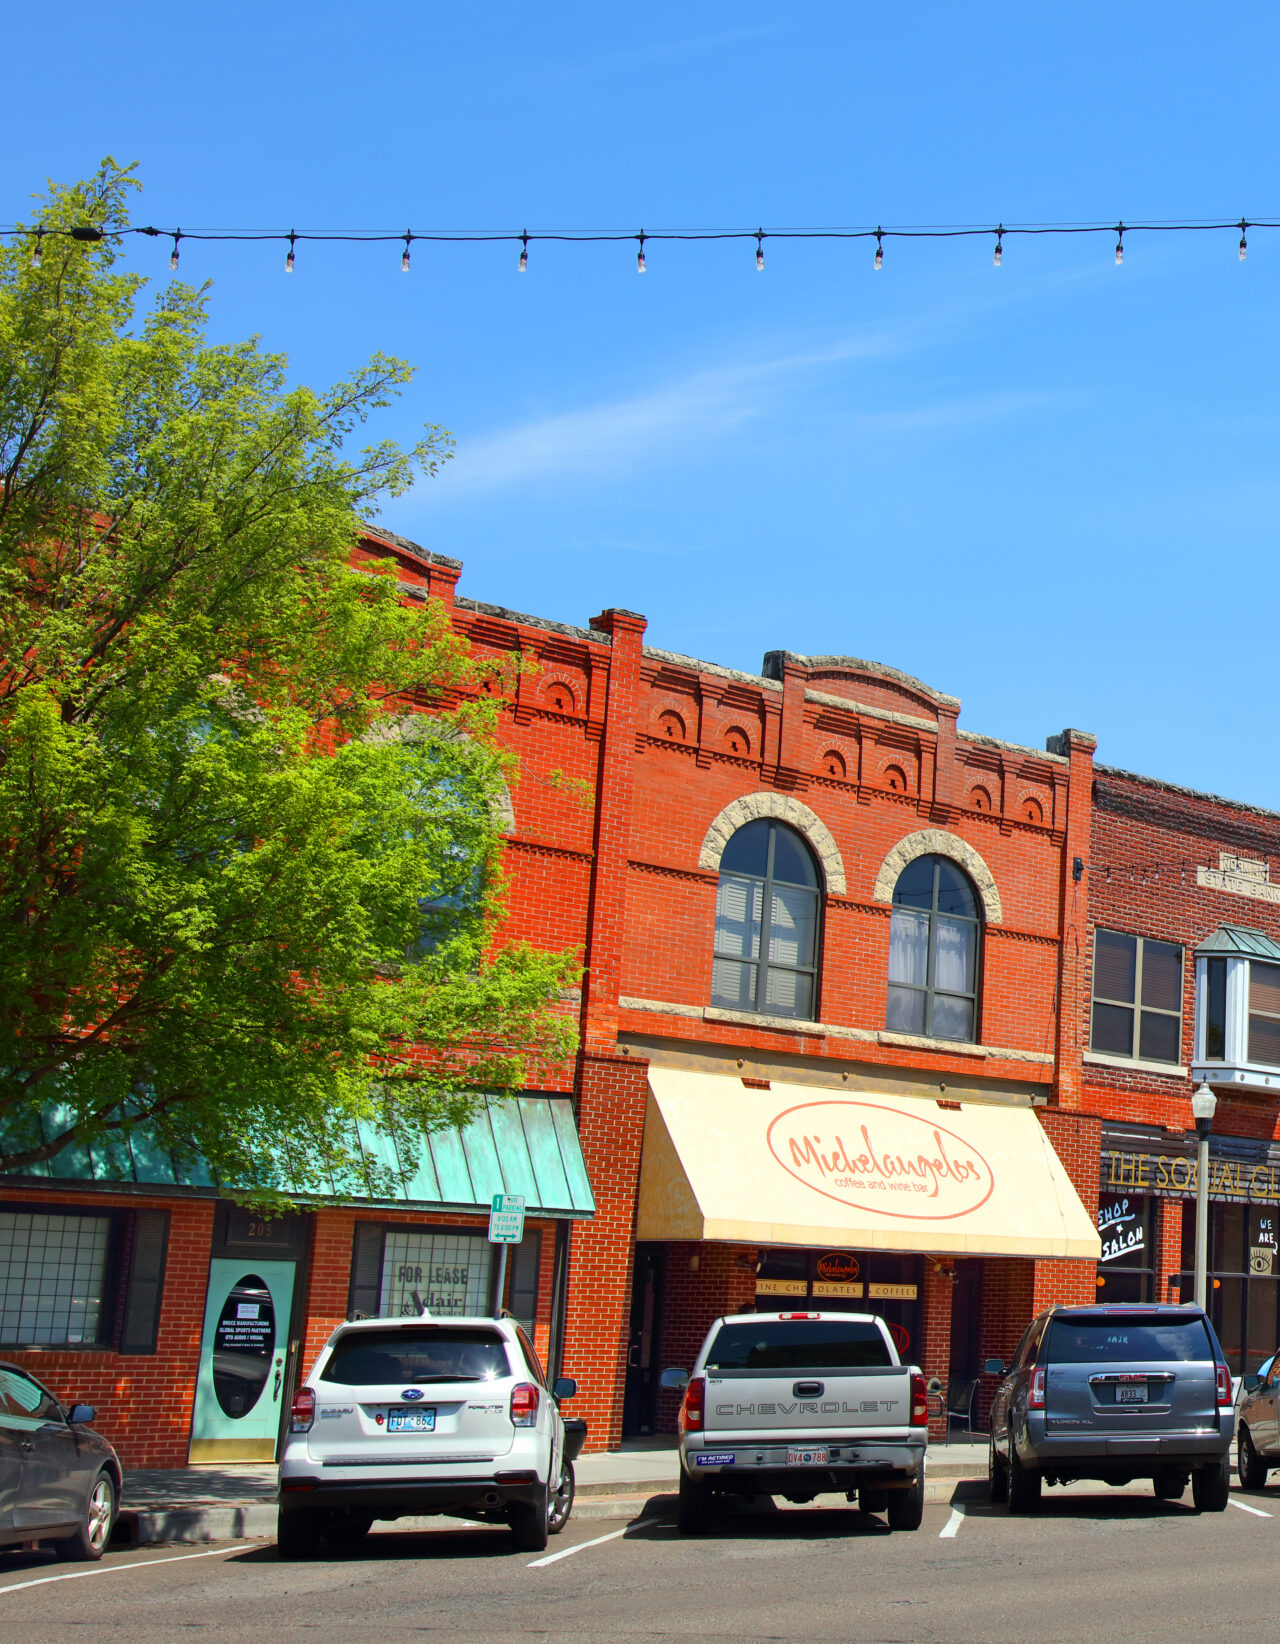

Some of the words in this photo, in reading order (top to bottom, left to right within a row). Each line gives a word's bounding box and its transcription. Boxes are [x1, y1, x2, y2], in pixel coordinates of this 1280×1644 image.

[1224, 859, 1265, 879] NORMAN
[1205, 872, 1242, 892] STATE
[788, 1124, 981, 1198] Michelangelos
[1108, 1150, 1149, 1186] THE
[834, 1177, 866, 1189] coffee
[868, 1180, 888, 1191] and
[888, 1183, 911, 1192] wine
[913, 1182, 929, 1193] bar
[496, 1198, 500, 1209] 1
[1098, 1199, 1129, 1225] SHOP
[248, 1222, 272, 1237] 205
[1260, 1219, 1273, 1230] WE
[1103, 1226, 1143, 1257] SALON
[1258, 1232, 1274, 1244] ARE
[398, 1266, 422, 1284] FOR
[429, 1267, 469, 1285] LEASE
[758, 1282, 777, 1291] INE
[876, 1287, 916, 1296] COFFEES
[716, 1400, 899, 1416] CHEVROLET
